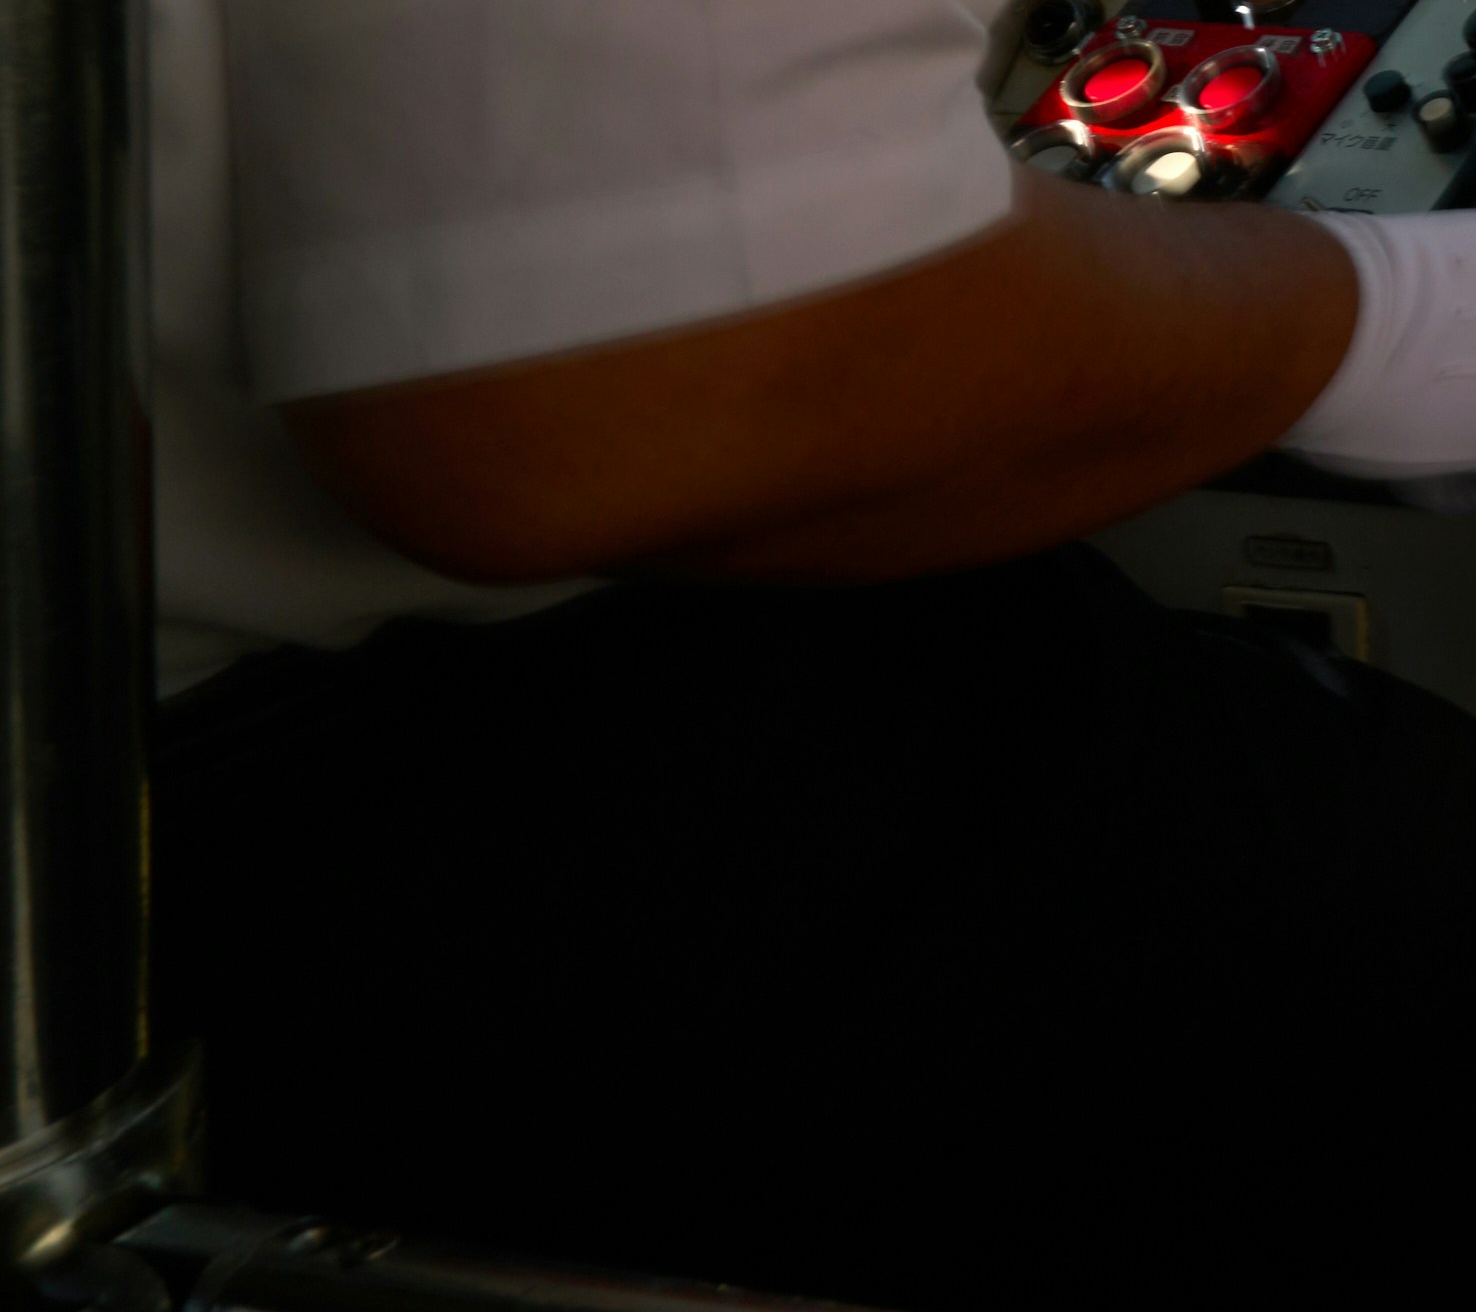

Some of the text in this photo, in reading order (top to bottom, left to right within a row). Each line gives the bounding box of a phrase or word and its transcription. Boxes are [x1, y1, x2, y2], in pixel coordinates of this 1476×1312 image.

[1321, 133, 1398, 151] マイク音量
[1343, 187, 1383, 203] OFF
